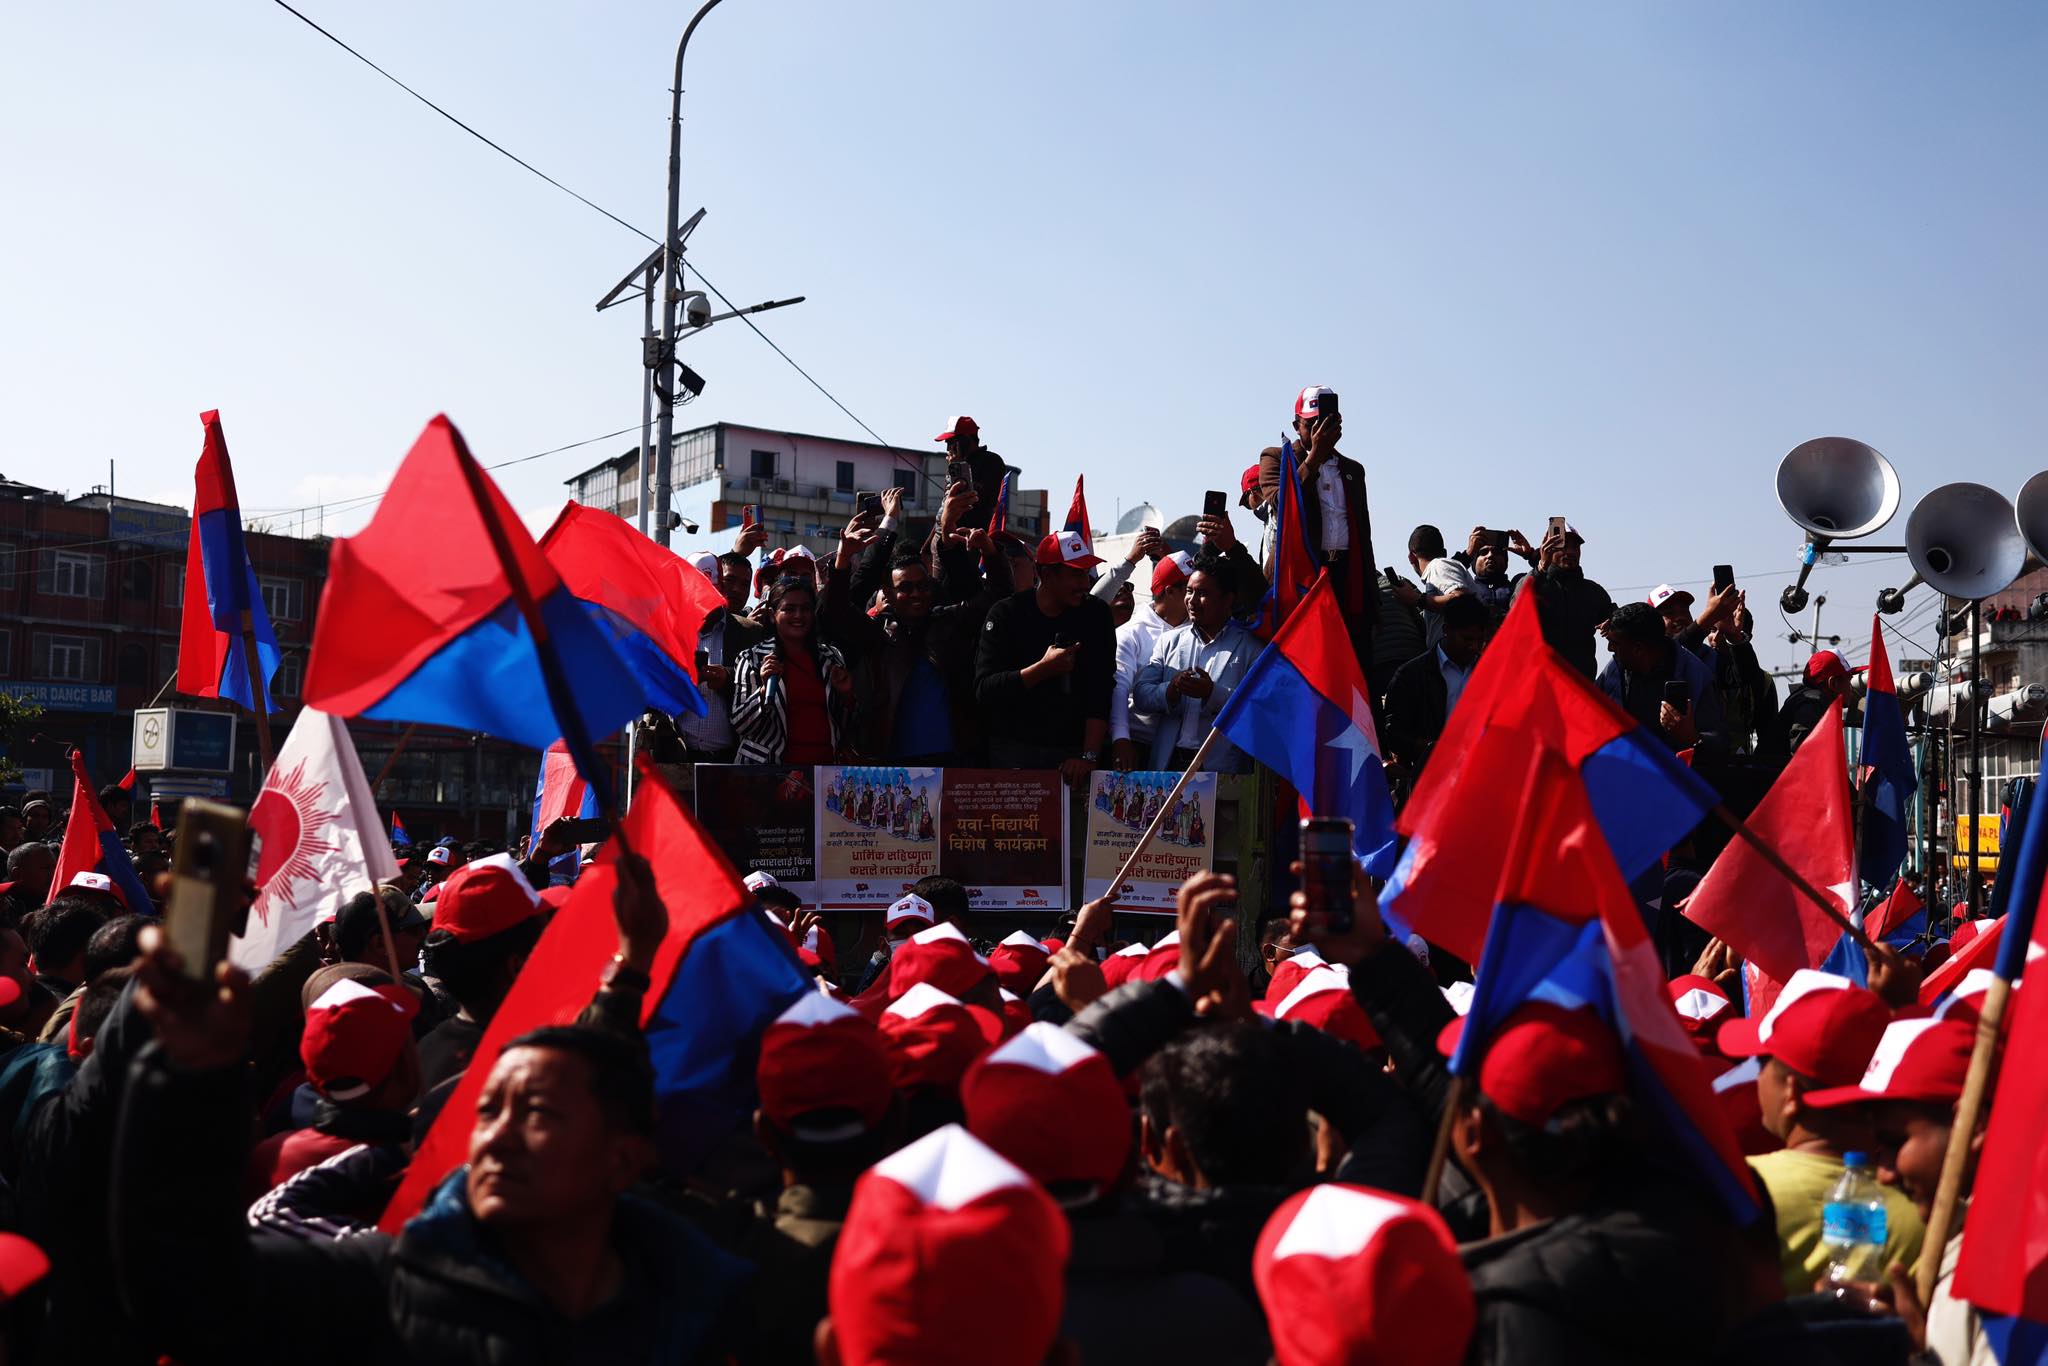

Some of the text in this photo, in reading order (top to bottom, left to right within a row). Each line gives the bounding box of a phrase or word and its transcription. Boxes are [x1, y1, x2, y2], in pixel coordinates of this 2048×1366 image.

[51, 687, 88, 702] DANCE
[91, 689, 113, 703] BAR
[949, 833, 1048, 852] विशेष कार्यक्रम
[852, 849, 933, 864] धार्मिक सहिष्णुता
[1155, 853, 1202, 869] सहिष्णुता
[849, 863, 878, 875] कसले
